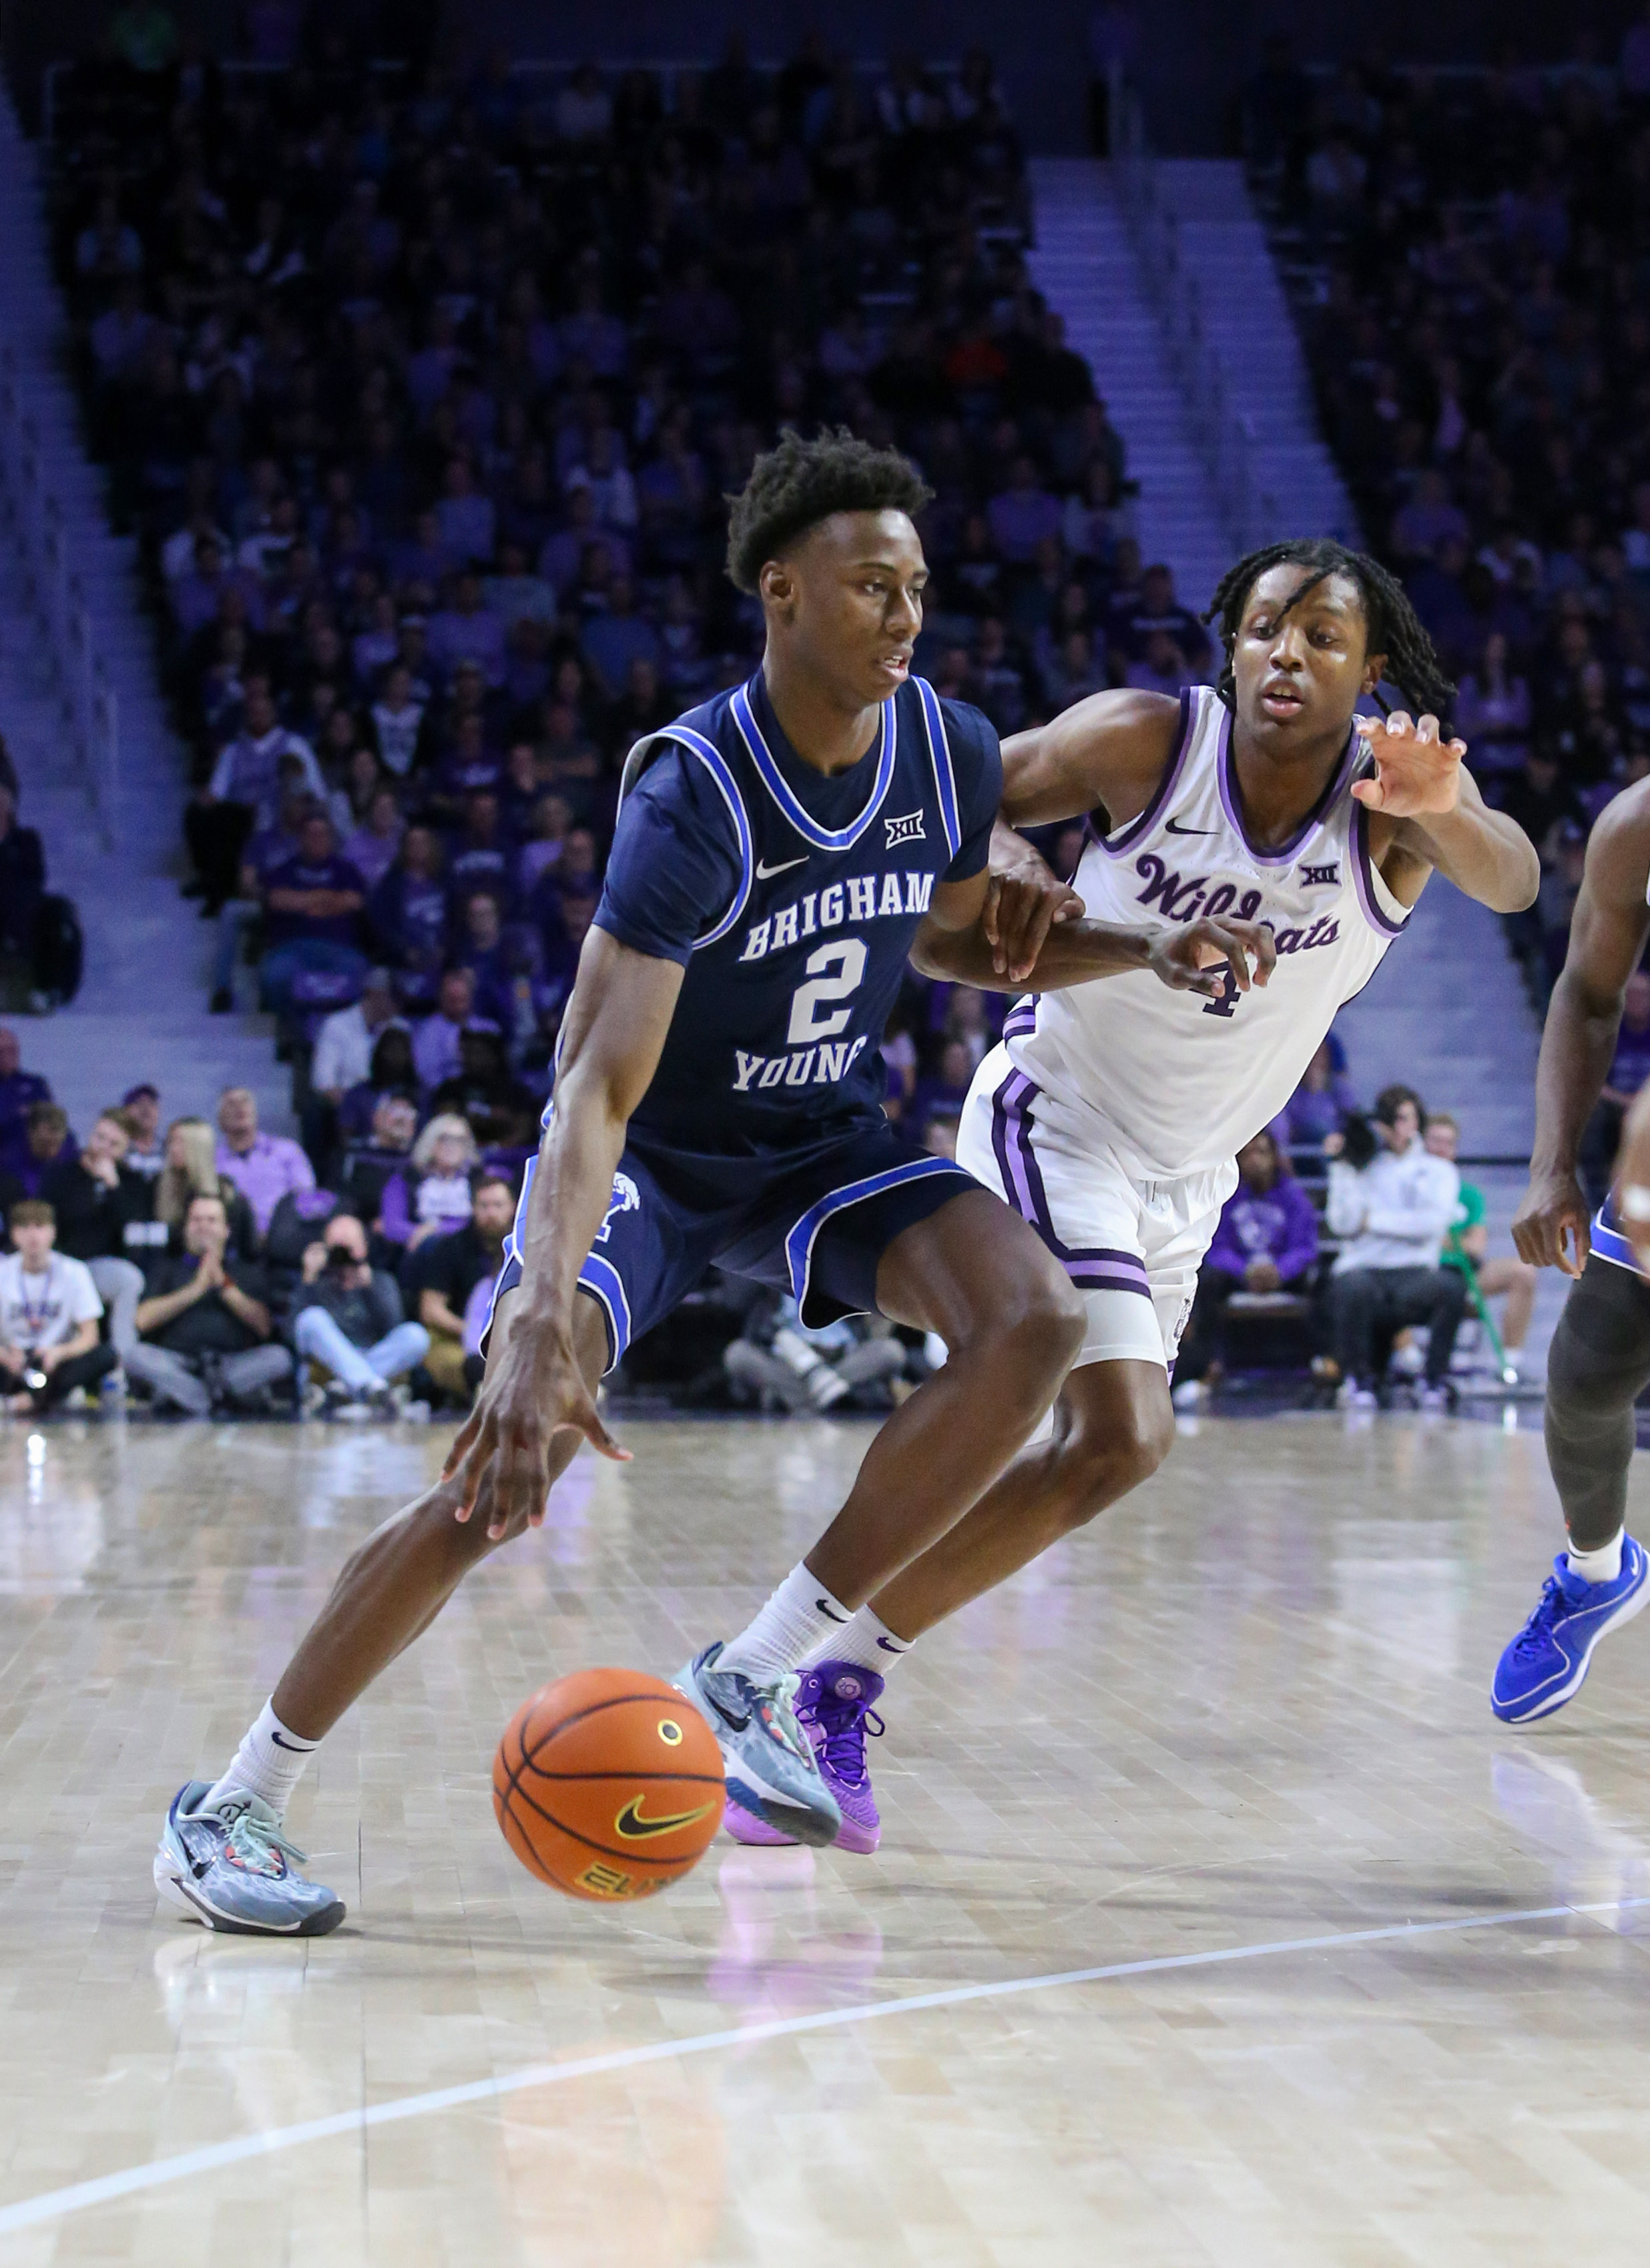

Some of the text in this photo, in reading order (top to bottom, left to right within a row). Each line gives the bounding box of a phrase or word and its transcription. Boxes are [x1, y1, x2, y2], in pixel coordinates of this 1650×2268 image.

[738, 872, 934, 962] BRIGHAM
[1136, 854, 1341, 955] Wildats
[787, 937, 868, 1045] 2
